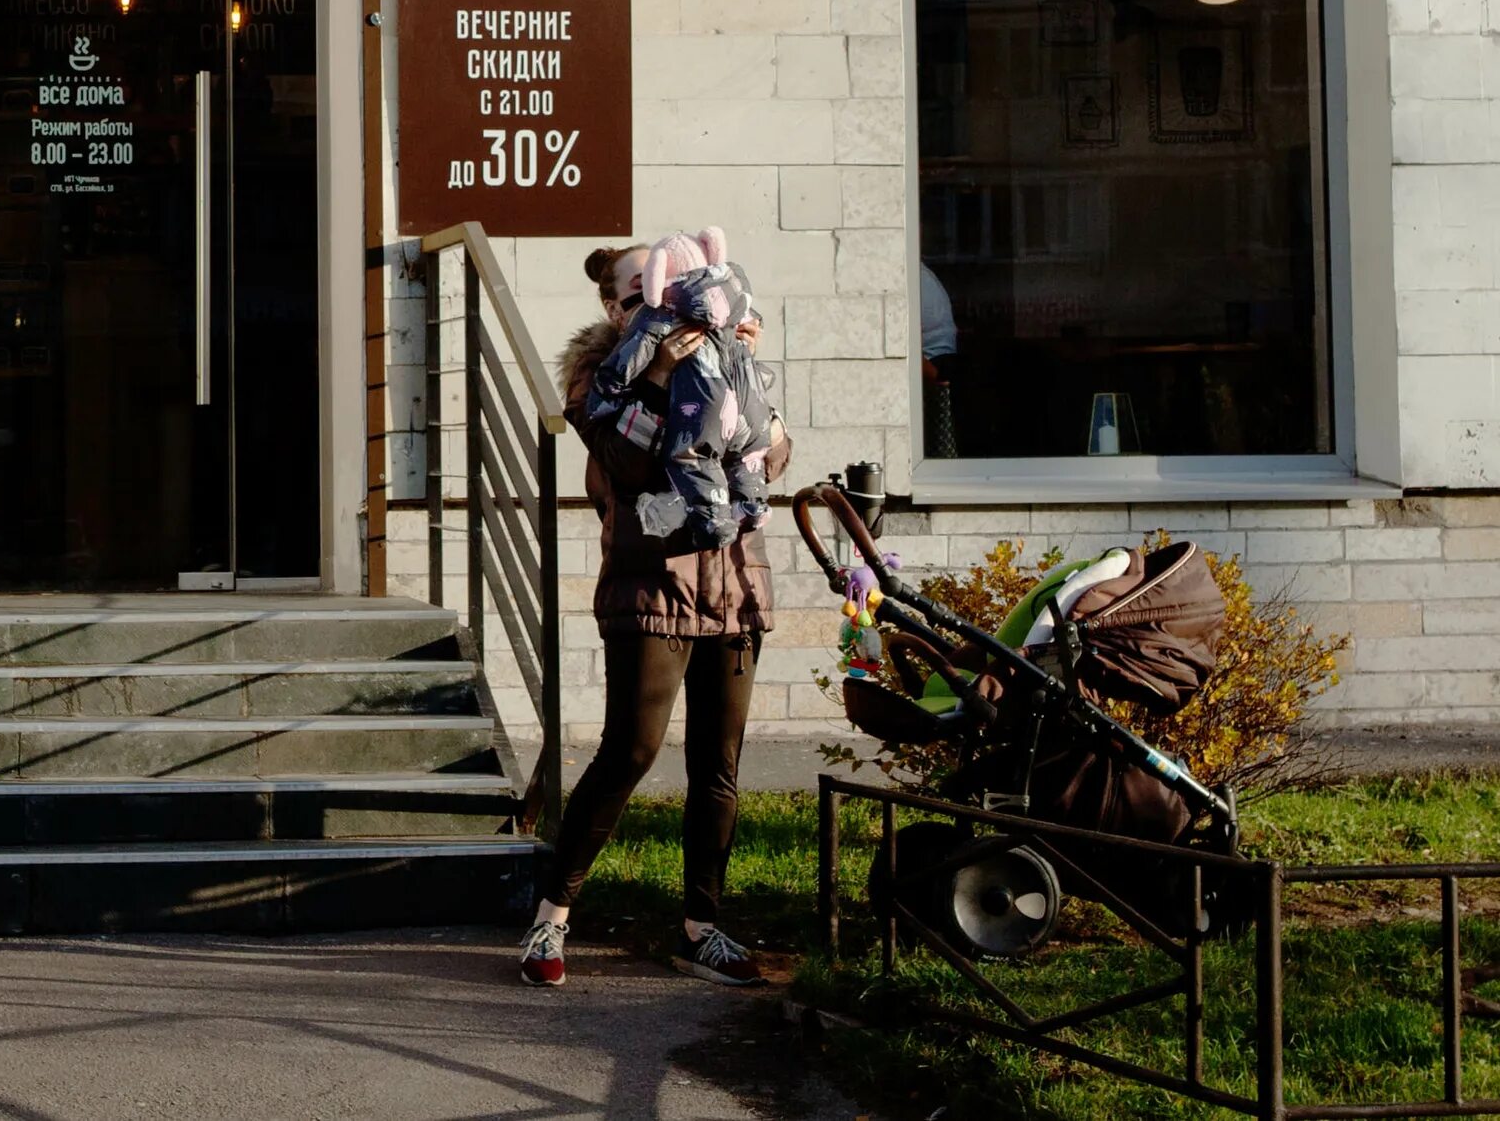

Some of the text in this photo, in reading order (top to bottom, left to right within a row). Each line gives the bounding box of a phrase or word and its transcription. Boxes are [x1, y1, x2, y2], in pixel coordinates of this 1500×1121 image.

[456, 10, 572, 40] ВЕЧЕРНИЕ
[467, 49, 561, 83] СКИДКИ
[39, 85, 125, 106] все дома
[480, 89, 554, 116] С 21.00
[31, 117, 133, 140] Режим работы
[30, 142, 67, 165] 8.00
[88, 142, 133, 165] 23.00
[482, 129, 581, 187] 30%
